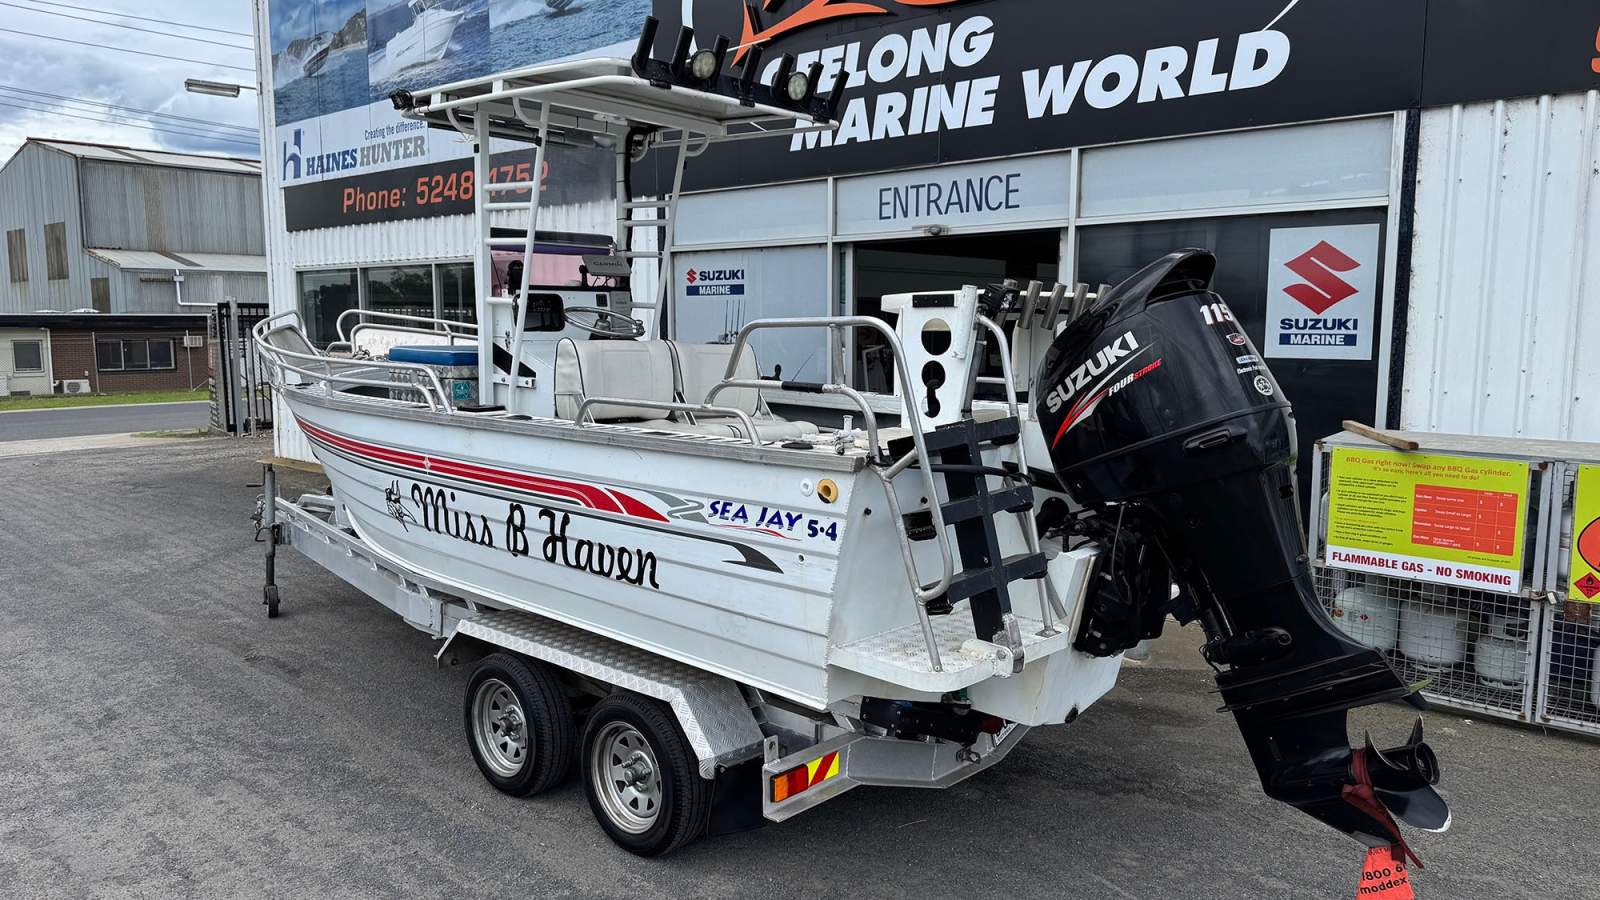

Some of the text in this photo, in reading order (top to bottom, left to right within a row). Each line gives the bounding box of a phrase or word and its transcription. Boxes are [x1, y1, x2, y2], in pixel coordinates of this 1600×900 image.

[790, 30, 1291, 151] MARINE WORLD
[365, 127, 385, 140] Creating
[386, 124, 395, 136] the
[306, 135, 426, 176] HAINES HUNTER
[343, 186, 407, 214] Phone:
[416, 172, 474, 205] 5248
[879, 173, 1021, 221] ENTRANCE
[699, 269, 745, 282] SUZUKI
[699, 284, 731, 295] MARINE
[1200, 303, 1234, 325] 115
[1280, 318, 1358, 331] SUZUKI
[1290, 333, 1345, 346] MARINE
[1046, 330, 1141, 414] SUZUKI
[1362, 457, 1375, 465] Gas
[1375, 458, 1392, 467] right
[1433, 465, 1446, 473] any
[1447, 465, 1463, 473] BBQ
[1445, 471, 1460, 479] need
[1461, 472, 1467, 480] to
[708, 500, 749, 523] SEA
[756, 506, 803, 531] JAY
[411, 483, 497, 549] Miss
[539, 508, 660, 590] Haven
[1332, 551, 1398, 569] FLAMMABLE
[1401, 561, 1424, 573] GAS
[1436, 566, 1452, 577] NO
[1456, 568, 1512, 586] SMOKING
[1360, 877, 1408, 894] moddex
